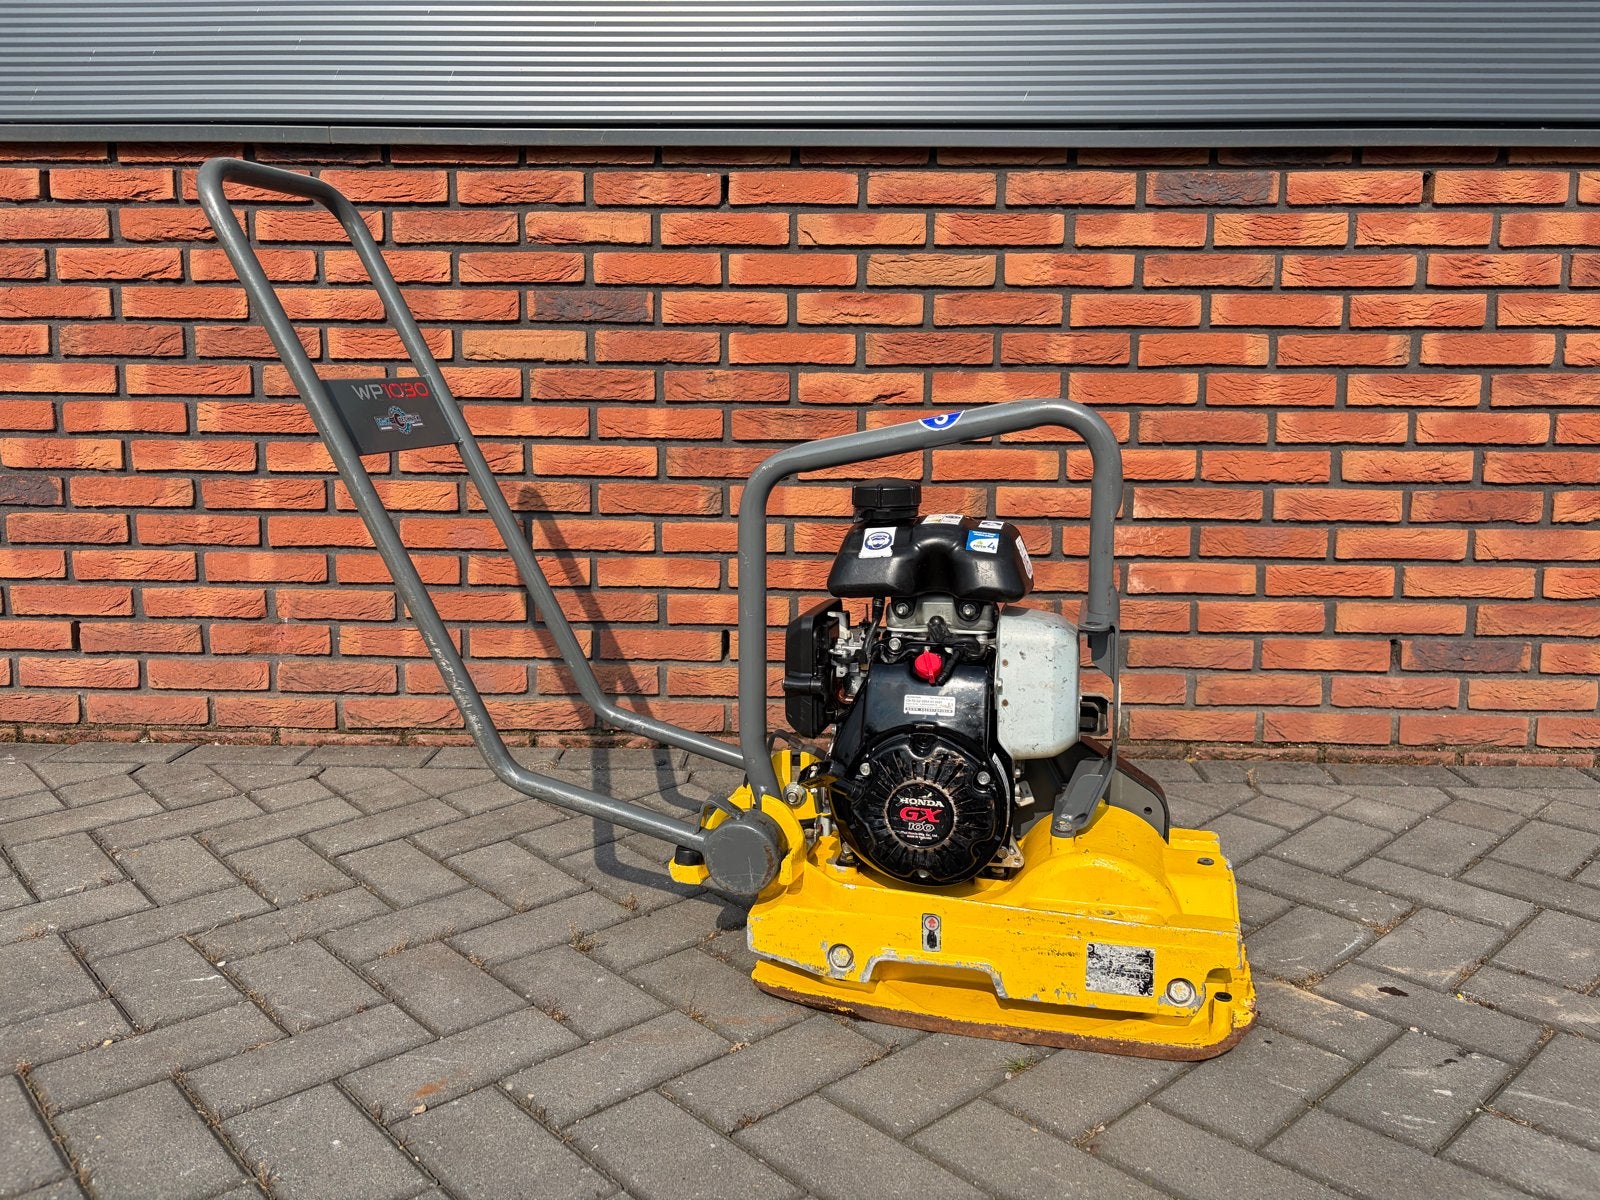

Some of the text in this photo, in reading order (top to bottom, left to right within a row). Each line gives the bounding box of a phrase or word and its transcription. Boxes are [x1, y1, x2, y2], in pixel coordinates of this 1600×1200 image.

[350, 381, 430, 401] WP1030
[898, 797, 945, 808] HONDA
[899, 806, 943, 823] GX
[907, 821, 935, 833] 100
